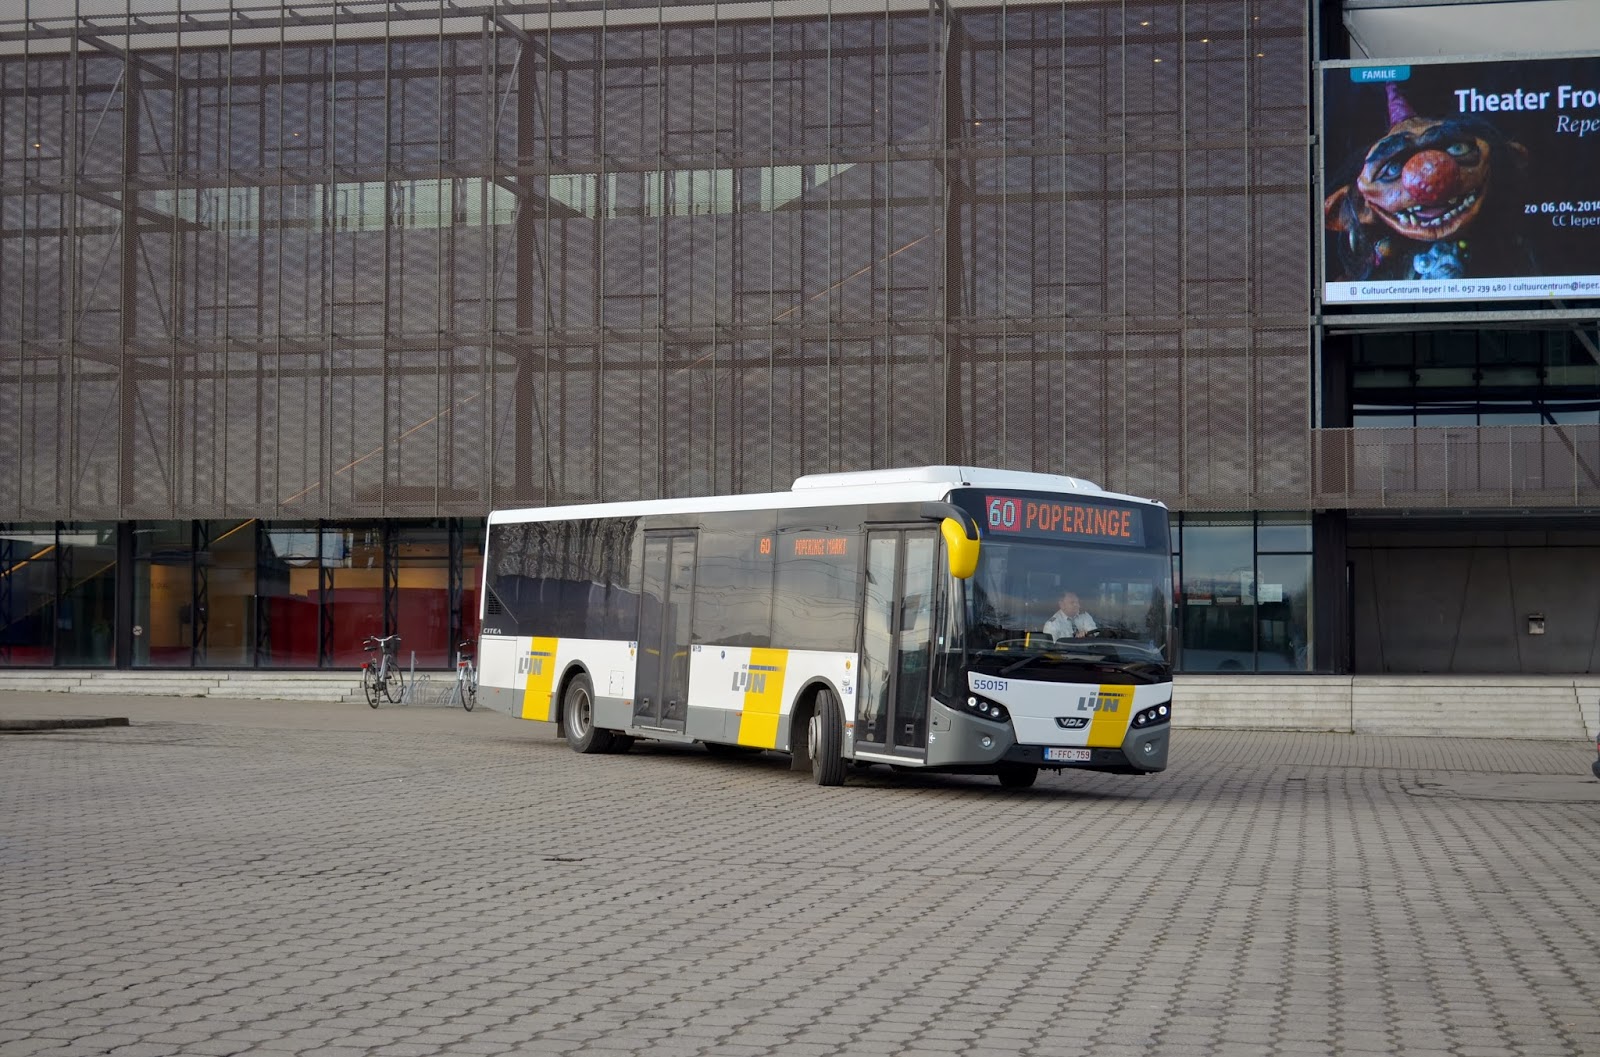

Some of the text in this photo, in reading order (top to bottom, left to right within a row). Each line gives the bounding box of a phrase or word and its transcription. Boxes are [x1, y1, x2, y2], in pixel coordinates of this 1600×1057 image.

[1362, 70, 1396, 79] FAMILIE
[1454, 85, 1600, 112] Theater Fro
[1556, 115, 1600, 137] Repe
[1524, 204, 1538, 214] zo
[1552, 215, 1566, 227] CC
[1361, 286, 1420, 295] CultuurCentrum
[1422, 286, 1441, 294] Ieper
[1448, 285, 1459, 293] tel.
[1462, 286, 1475, 294] 057
[1492, 284, 1506, 293] 480
[989, 499, 1131, 537] 60 POPERINGE
[760, 538, 771, 554] 60
[974, 680, 1008, 691] 550151
[1077, 697, 1119, 712] LIJN
[1060, 719, 1084, 727] VDL
[1050, 750, 1090, 759] 1-FFC-759
